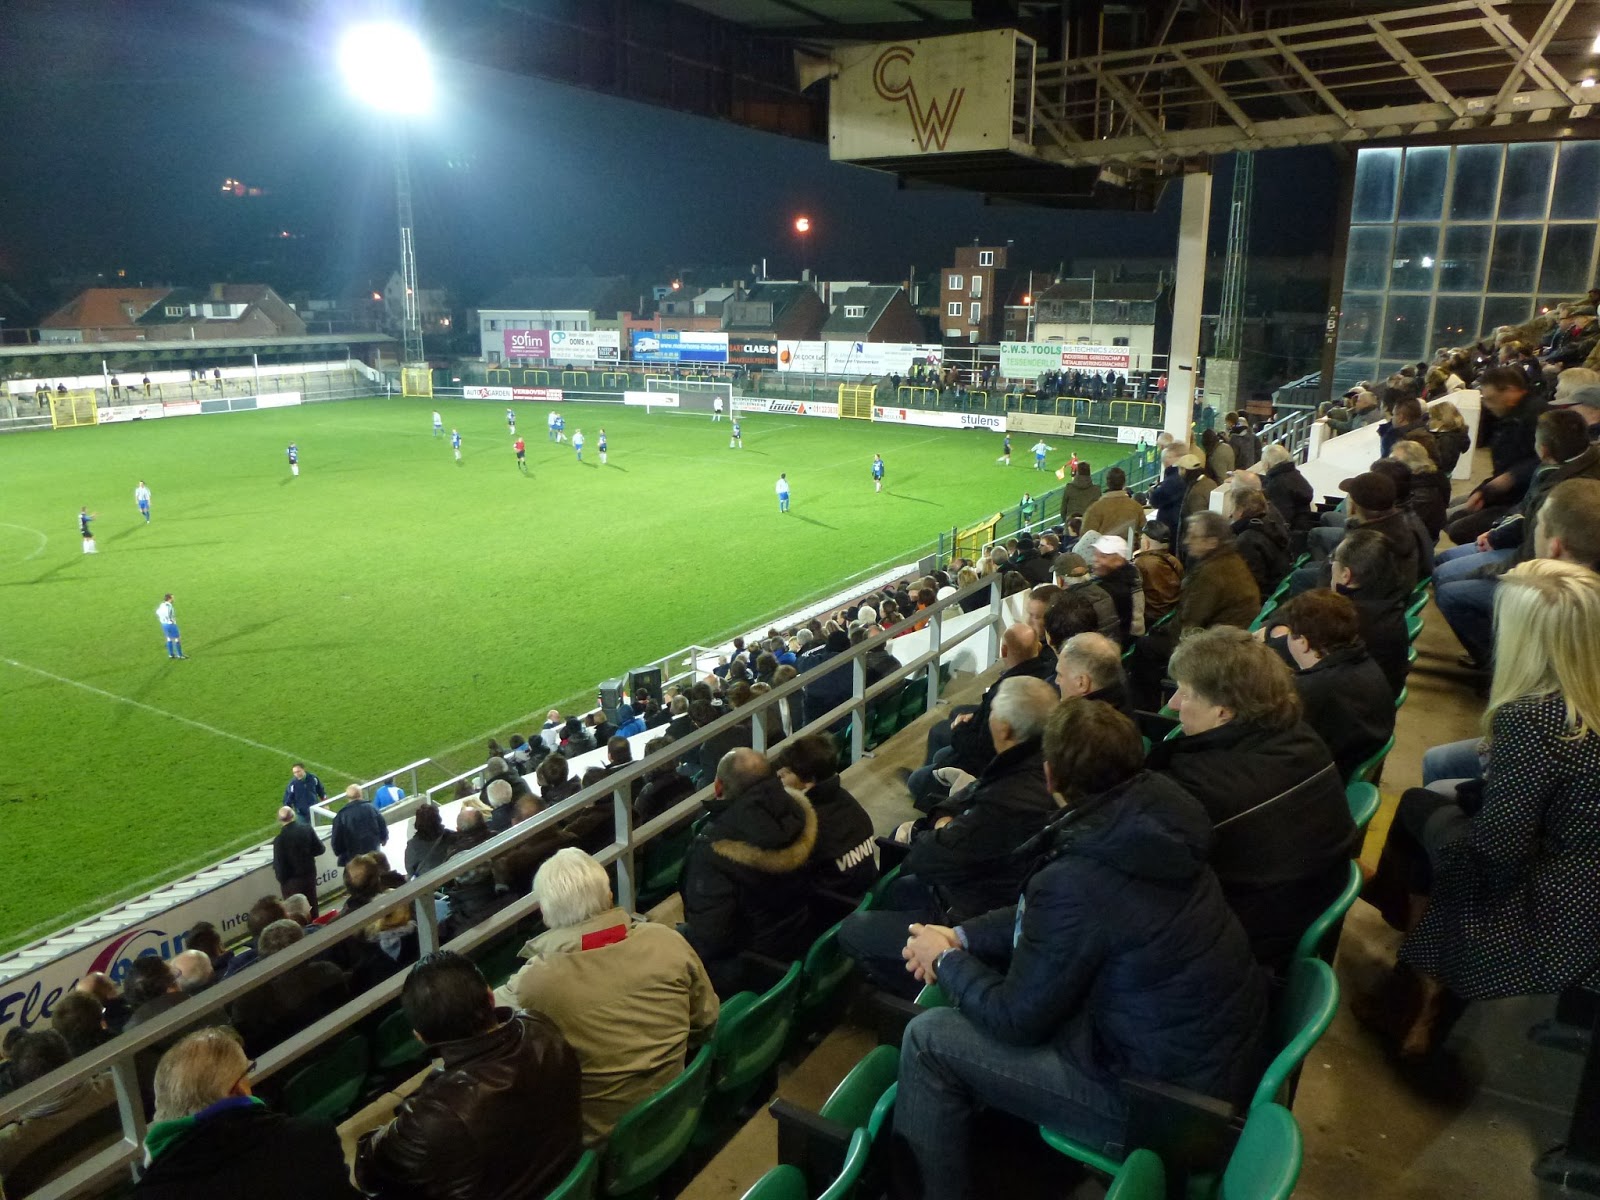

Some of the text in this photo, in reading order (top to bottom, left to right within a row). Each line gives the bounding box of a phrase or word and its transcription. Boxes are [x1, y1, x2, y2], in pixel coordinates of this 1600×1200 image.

[873, 46, 965, 151] CW
[1326, 319, 1336, 330] B
[511, 331, 543, 347] sofim
[743, 344, 769, 353] CLAES
[1001, 344, 1062, 355] C.W.S. TOOLS
[1006, 357, 1056, 367] TESSENDERLO
[488, 389, 511, 397] GARDEN
[961, 415, 1000, 427] stulens
[221, 911, 250, 932] Inte
